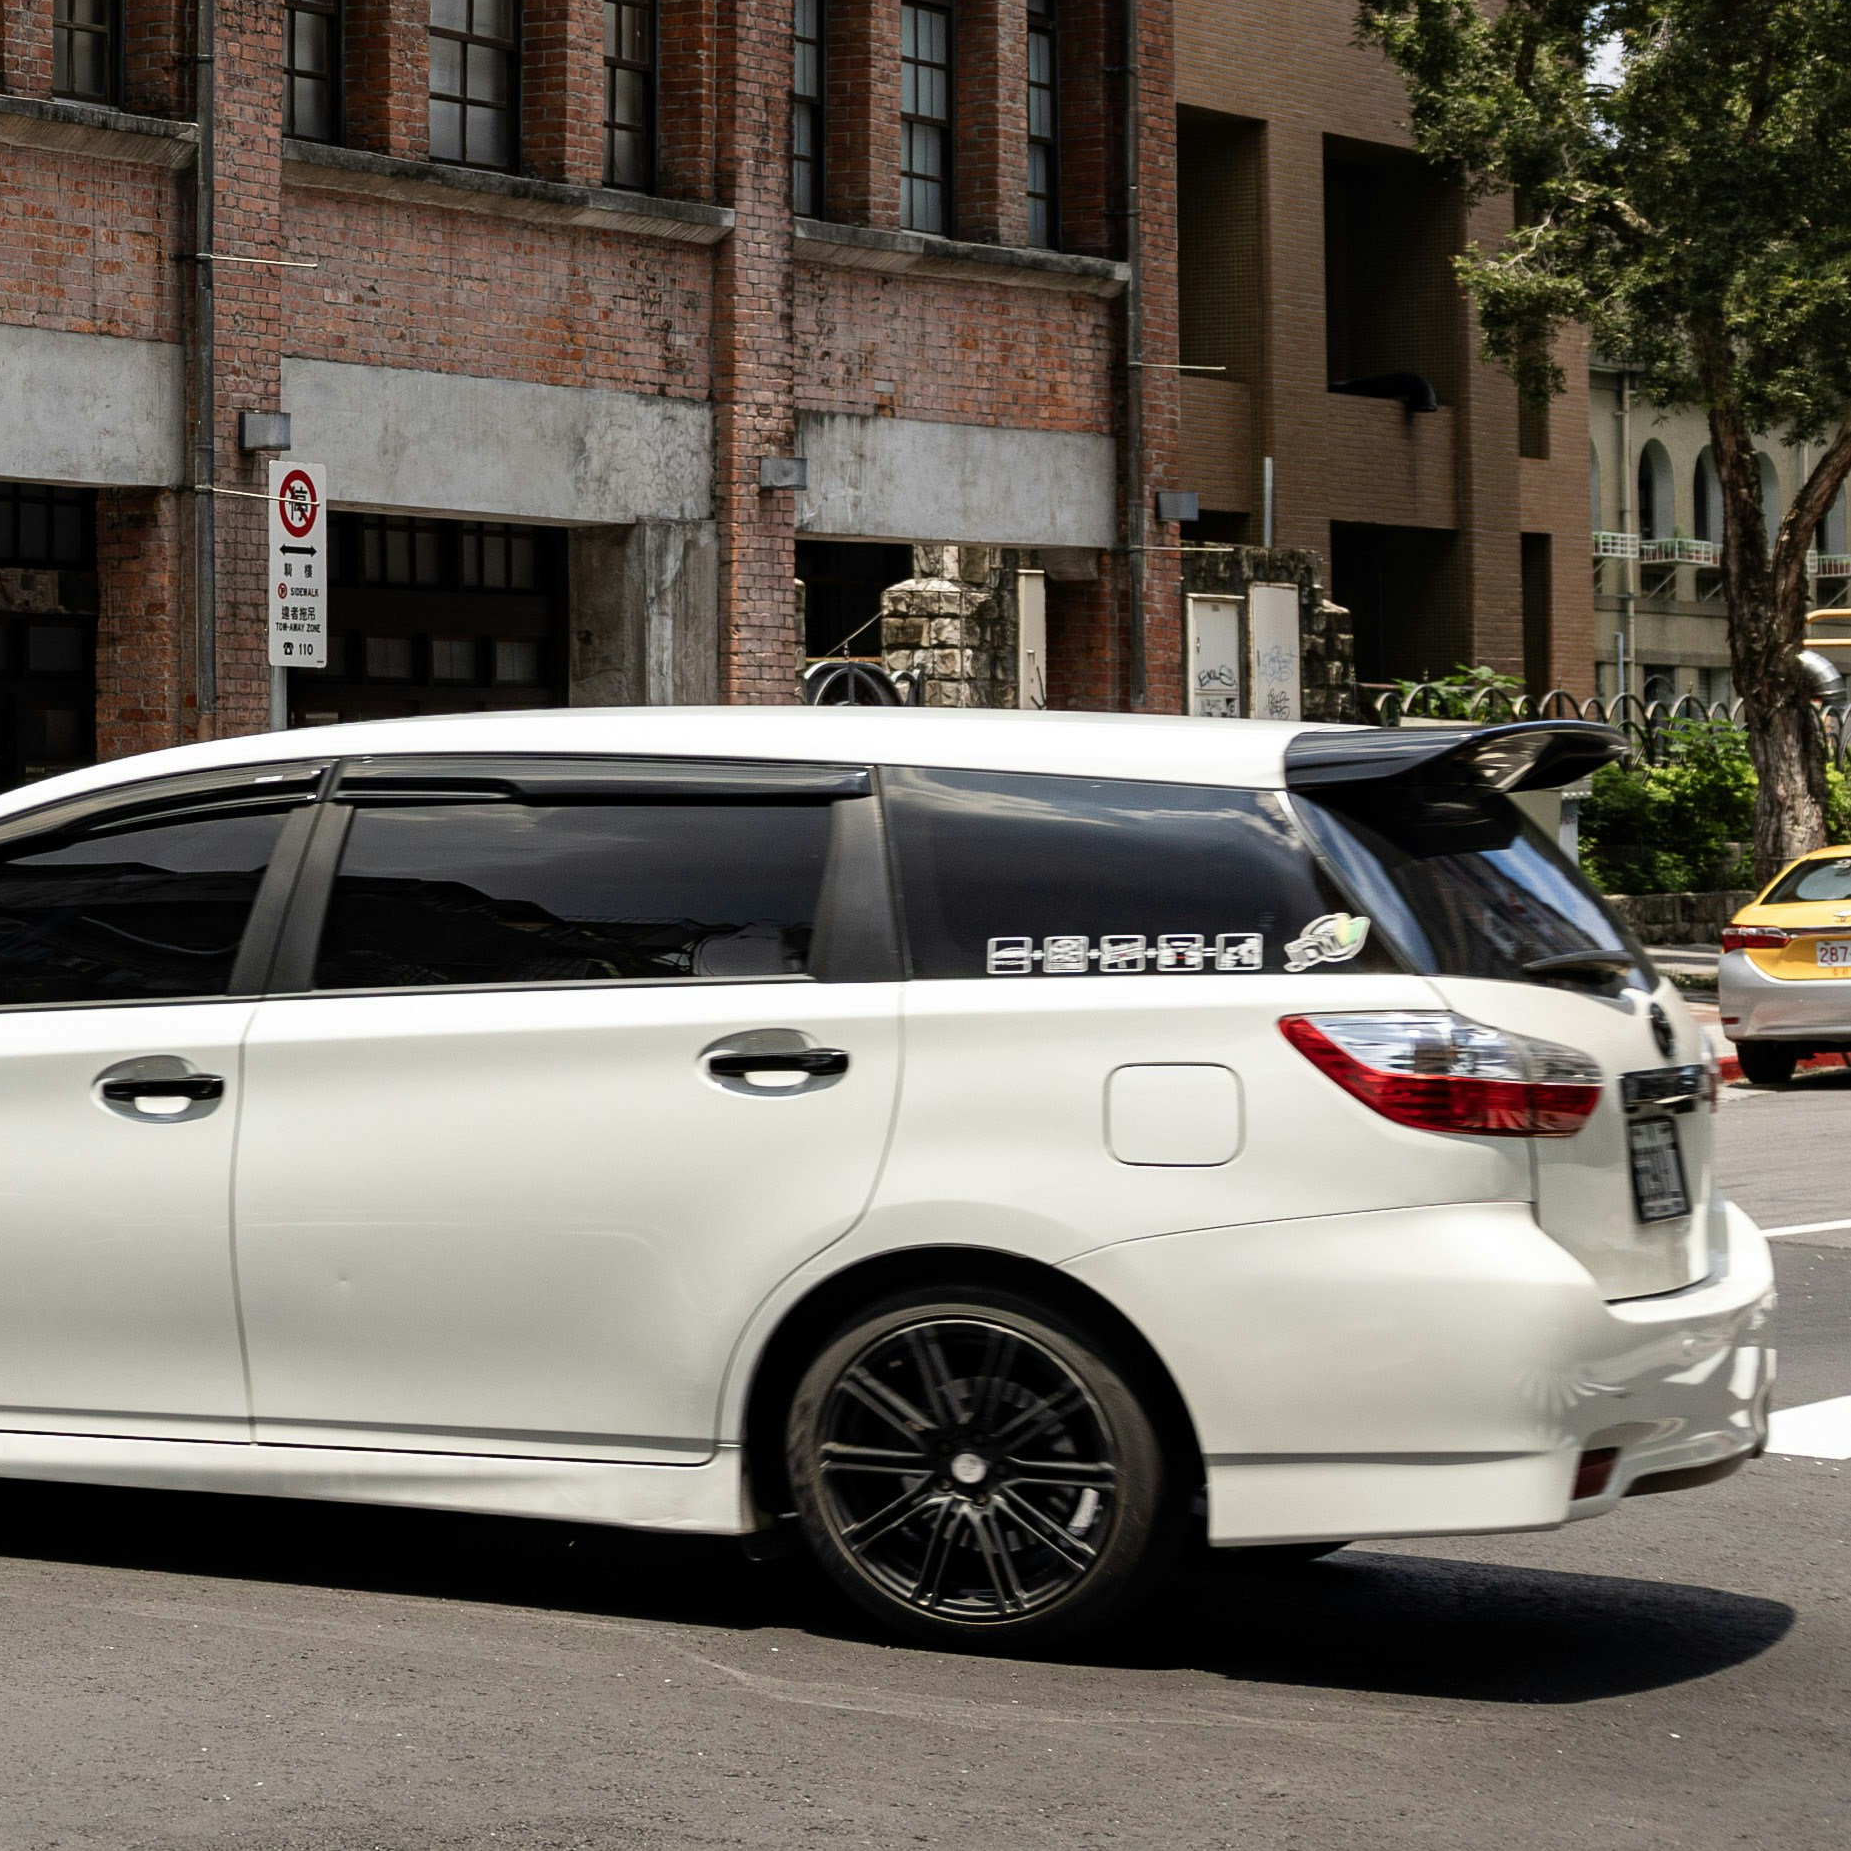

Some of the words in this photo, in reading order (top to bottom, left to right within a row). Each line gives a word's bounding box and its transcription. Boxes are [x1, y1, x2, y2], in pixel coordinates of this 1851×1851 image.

[290, 587, 319, 597] SIDEWALK
[281, 606, 316, 621] 違者拖吊
[275, 622, 305, 632] TOW-AWAY
[306, 623, 321, 633] ZONE
[299, 643, 314, 656] 110
